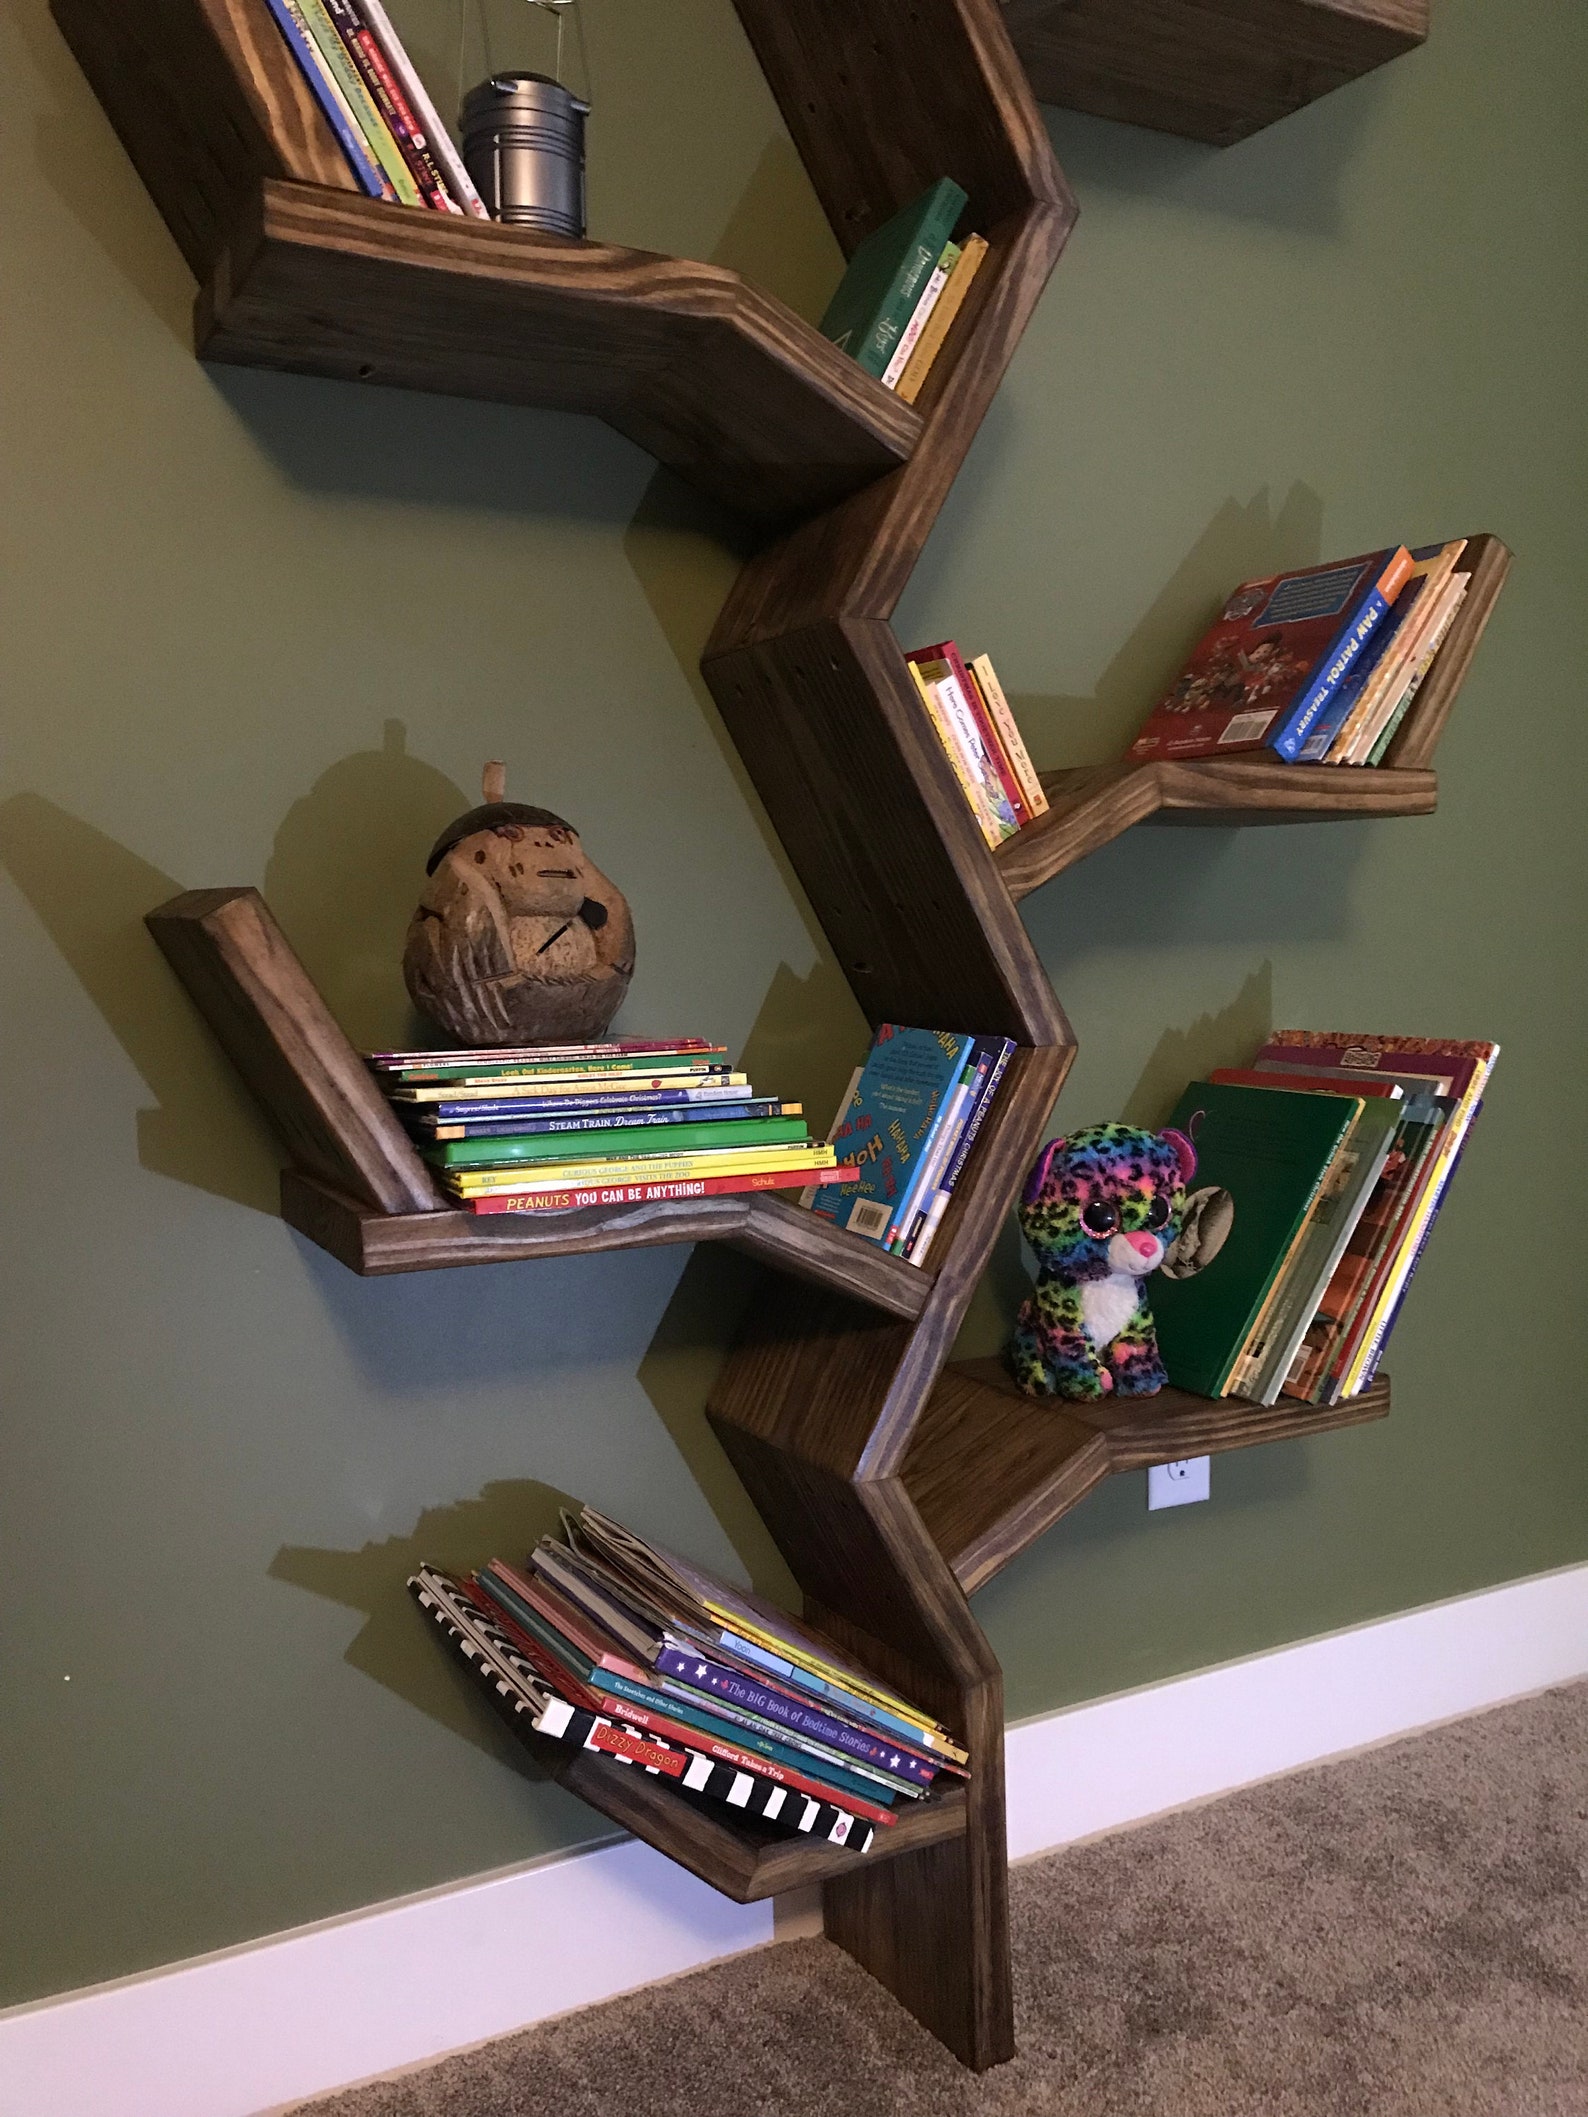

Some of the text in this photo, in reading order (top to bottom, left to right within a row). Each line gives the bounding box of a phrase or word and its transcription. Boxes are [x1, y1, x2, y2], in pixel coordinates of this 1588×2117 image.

[1353, 606, 1380, 641] PAW
[1325, 637, 1360, 686] PATROL
[1293, 685, 1330, 737] TREASURY
[943, 686, 960, 709] Here
[953, 707, 973, 739] Comes
[966, 737, 982, 760] Peter
[998, 1050, 1011, 1067] THE
[501, 1068, 520, 1076] Look
[522, 1067, 535, 1075] Out
[991, 1066, 1004, 1083] JOY
[521, 1086, 539, 1094] Sick
[540, 1085, 558, 1095] Day
[982, 1097, 991, 1105] A
[986, 1084, 997, 1096] OF
[549, 1113, 669, 1131] STEAM TRAIN, Dream Train
[966, 1105, 987, 1141] PEANUTS
[1335, 1132, 1344, 1144] the
[947, 1141, 971, 1187] CHRISTMAS
[481, 1175, 496, 1184] REY
[506, 1194, 570, 1210] PEANUTS
[574, 1192, 598, 1205] YOU
[601, 1190, 624, 1202] CAN
[627, 1188, 642, 1200] BE
[1356, 1347, 1376, 1380] BROWN
[734, 1642, 750, 1653] Yoon
[613, 1681, 623, 1690] The
[645, 1694, 655, 1702] and
[653, 1697, 668, 1708] Other
[614, 1704, 648, 1725] Bridwell
[728, 1681, 871, 1753] The BIG Book of Bedtime Stories
[596, 1726, 679, 1769] Dizzy Dragon
[712, 1745, 739, 1762] Clifford
[741, 1756, 763, 1771] Takes
[767, 1765, 784, 1781] Trip
